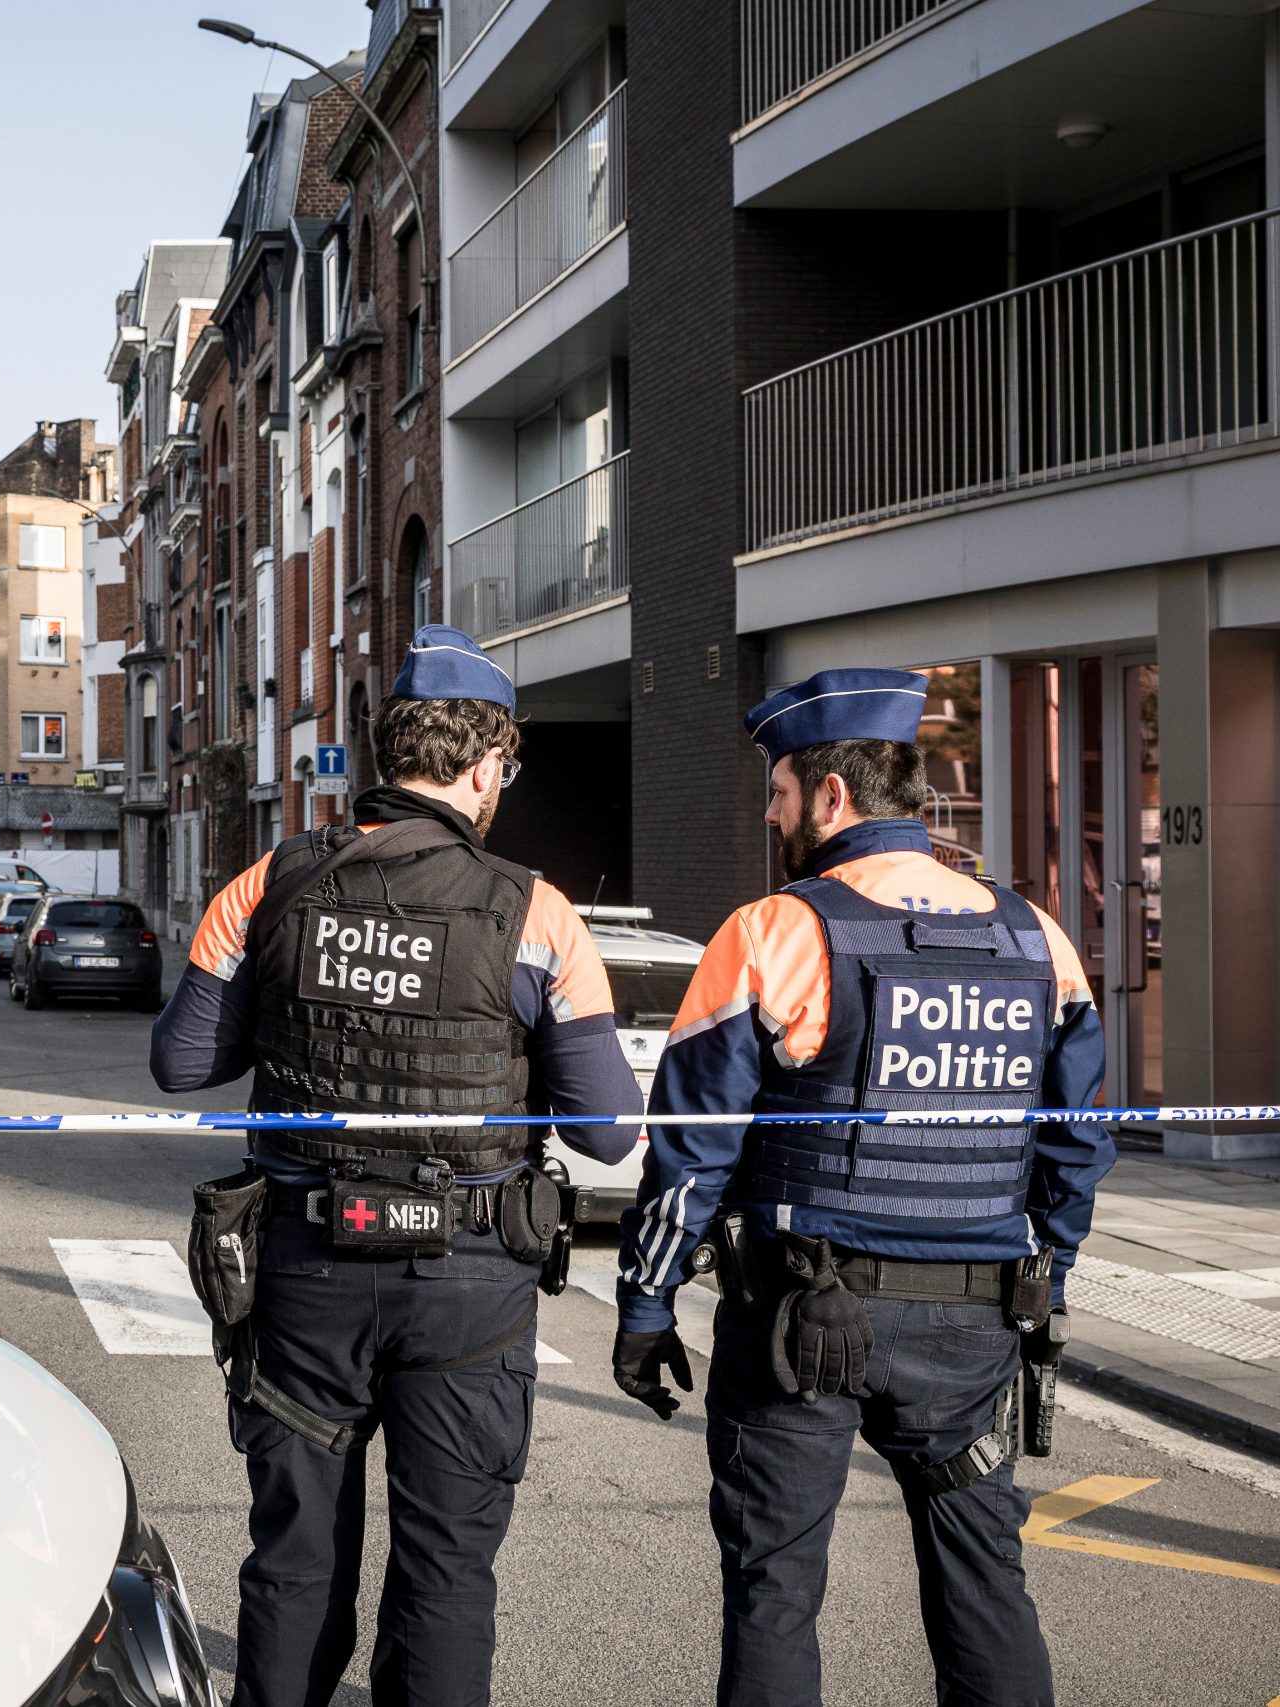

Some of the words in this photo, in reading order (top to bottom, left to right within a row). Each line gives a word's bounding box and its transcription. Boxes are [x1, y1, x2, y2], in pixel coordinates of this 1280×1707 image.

[1162, 805, 1203, 846] 19/3
[315, 915, 434, 962] Police
[317, 953, 423, 1006] Liege
[891, 984, 1033, 1032] Police
[879, 1043, 1033, 1088] Politie
[389, 1203, 440, 1230] MED
